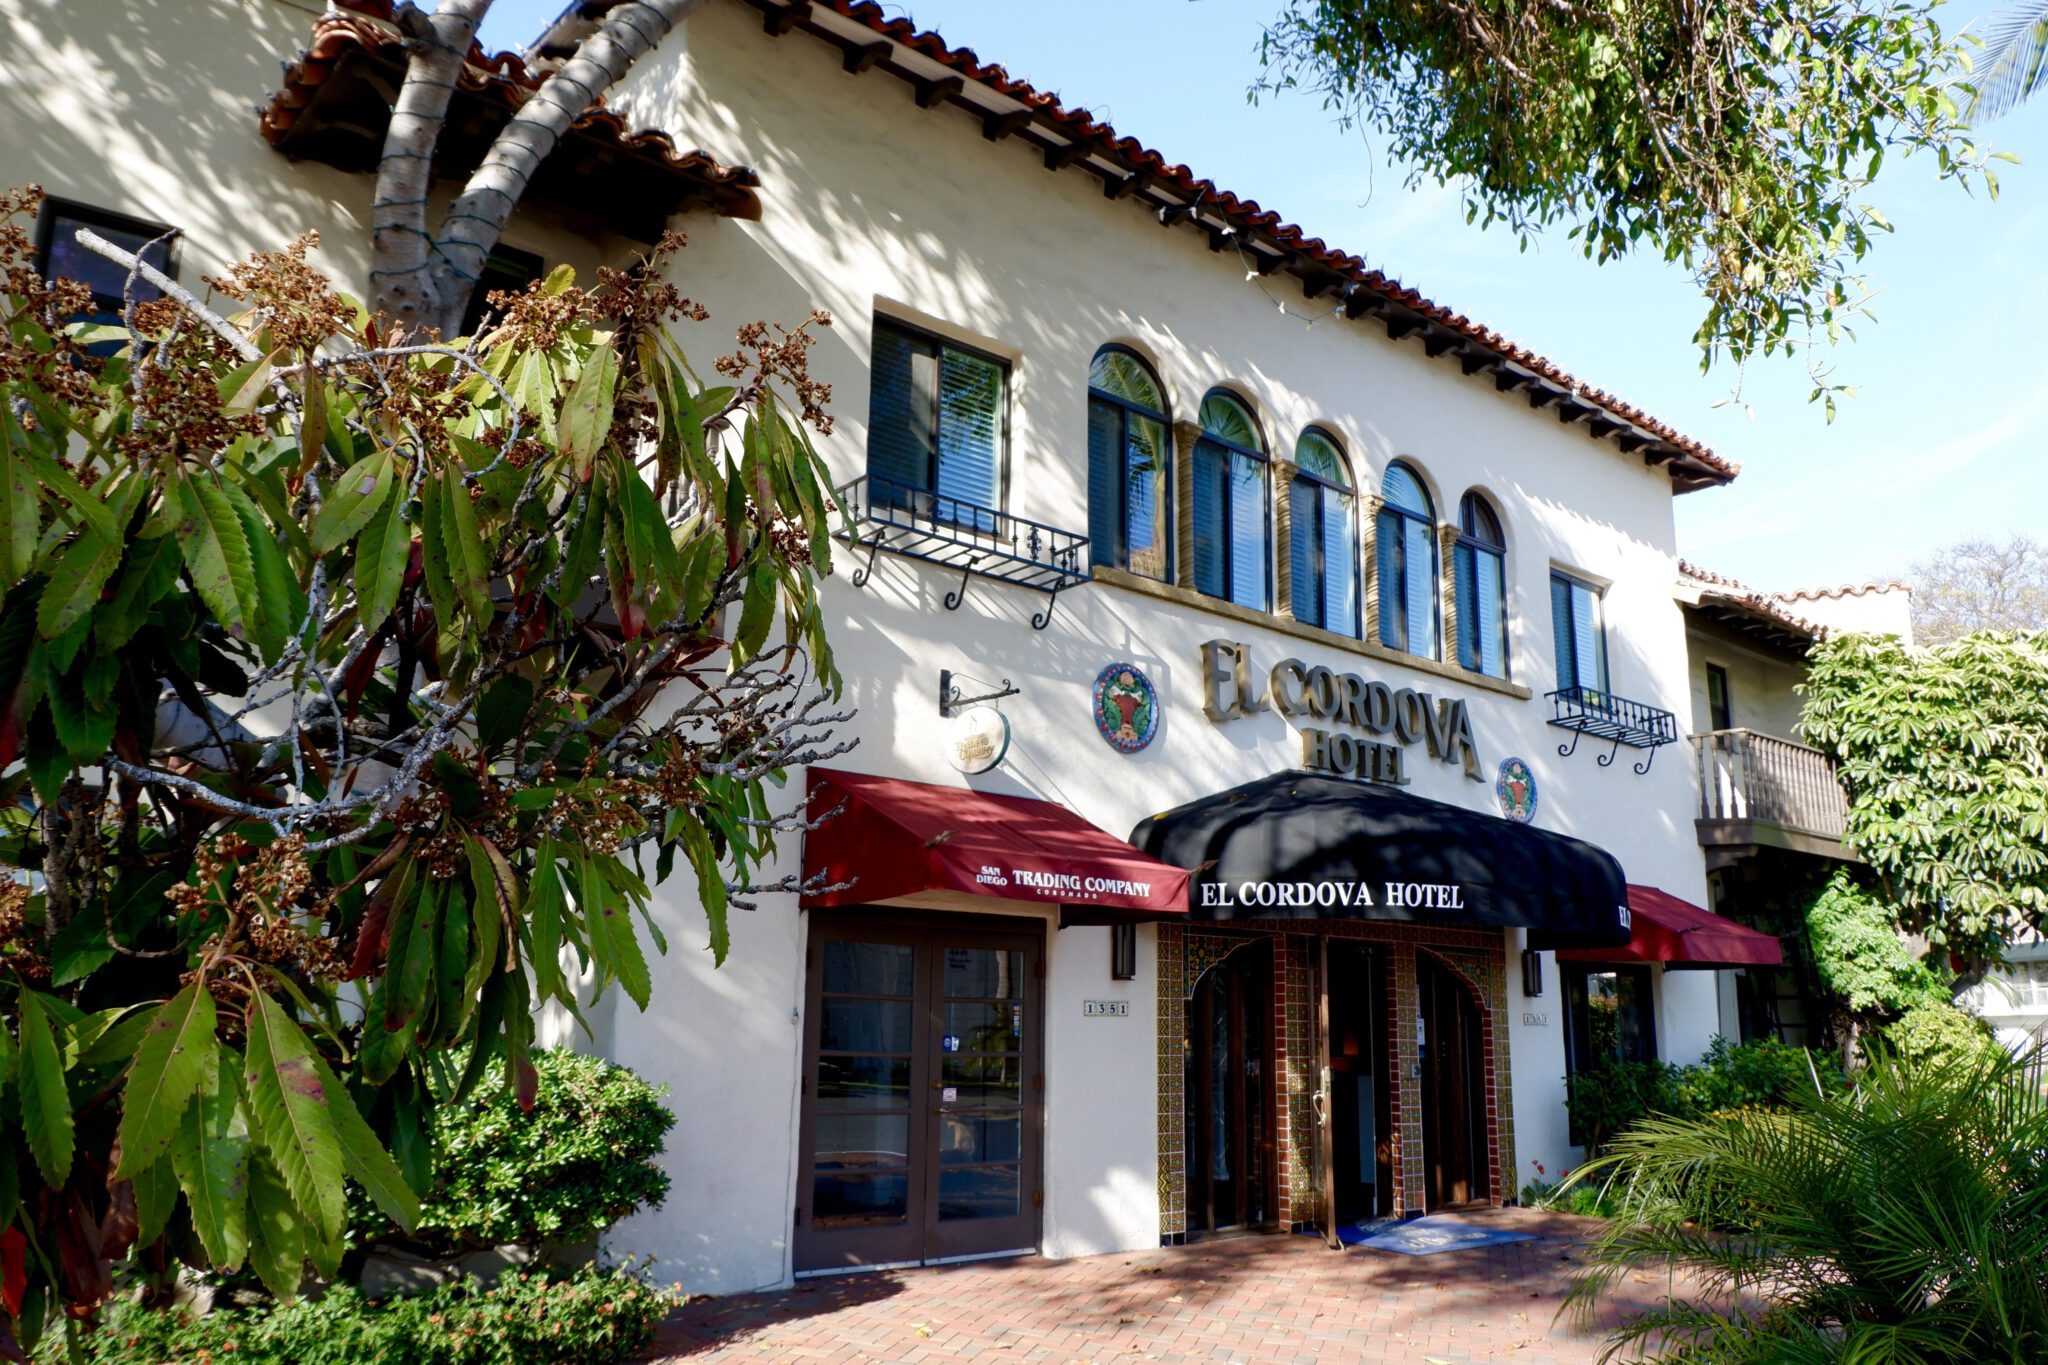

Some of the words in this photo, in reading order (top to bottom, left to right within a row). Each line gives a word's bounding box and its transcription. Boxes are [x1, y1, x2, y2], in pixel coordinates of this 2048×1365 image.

[1200, 638, 1272, 722] EL
[1269, 657, 1487, 783] CORDOVA
[1301, 727, 1411, 786] HOTEL
[976, 874, 1008, 886] DIEGO
[981, 865, 1001, 876] SAN
[1012, 869, 1081, 890] TRADING
[1084, 876, 1151, 897] COMPANY
[1036, 888, 1098, 899] CORONADO
[1200, 882, 1234, 907] EL
[1238, 881, 1374, 907] CORDOVA
[1385, 882, 1465, 909] HOTEL
[1087, 1003, 1126, 1014] 1351
